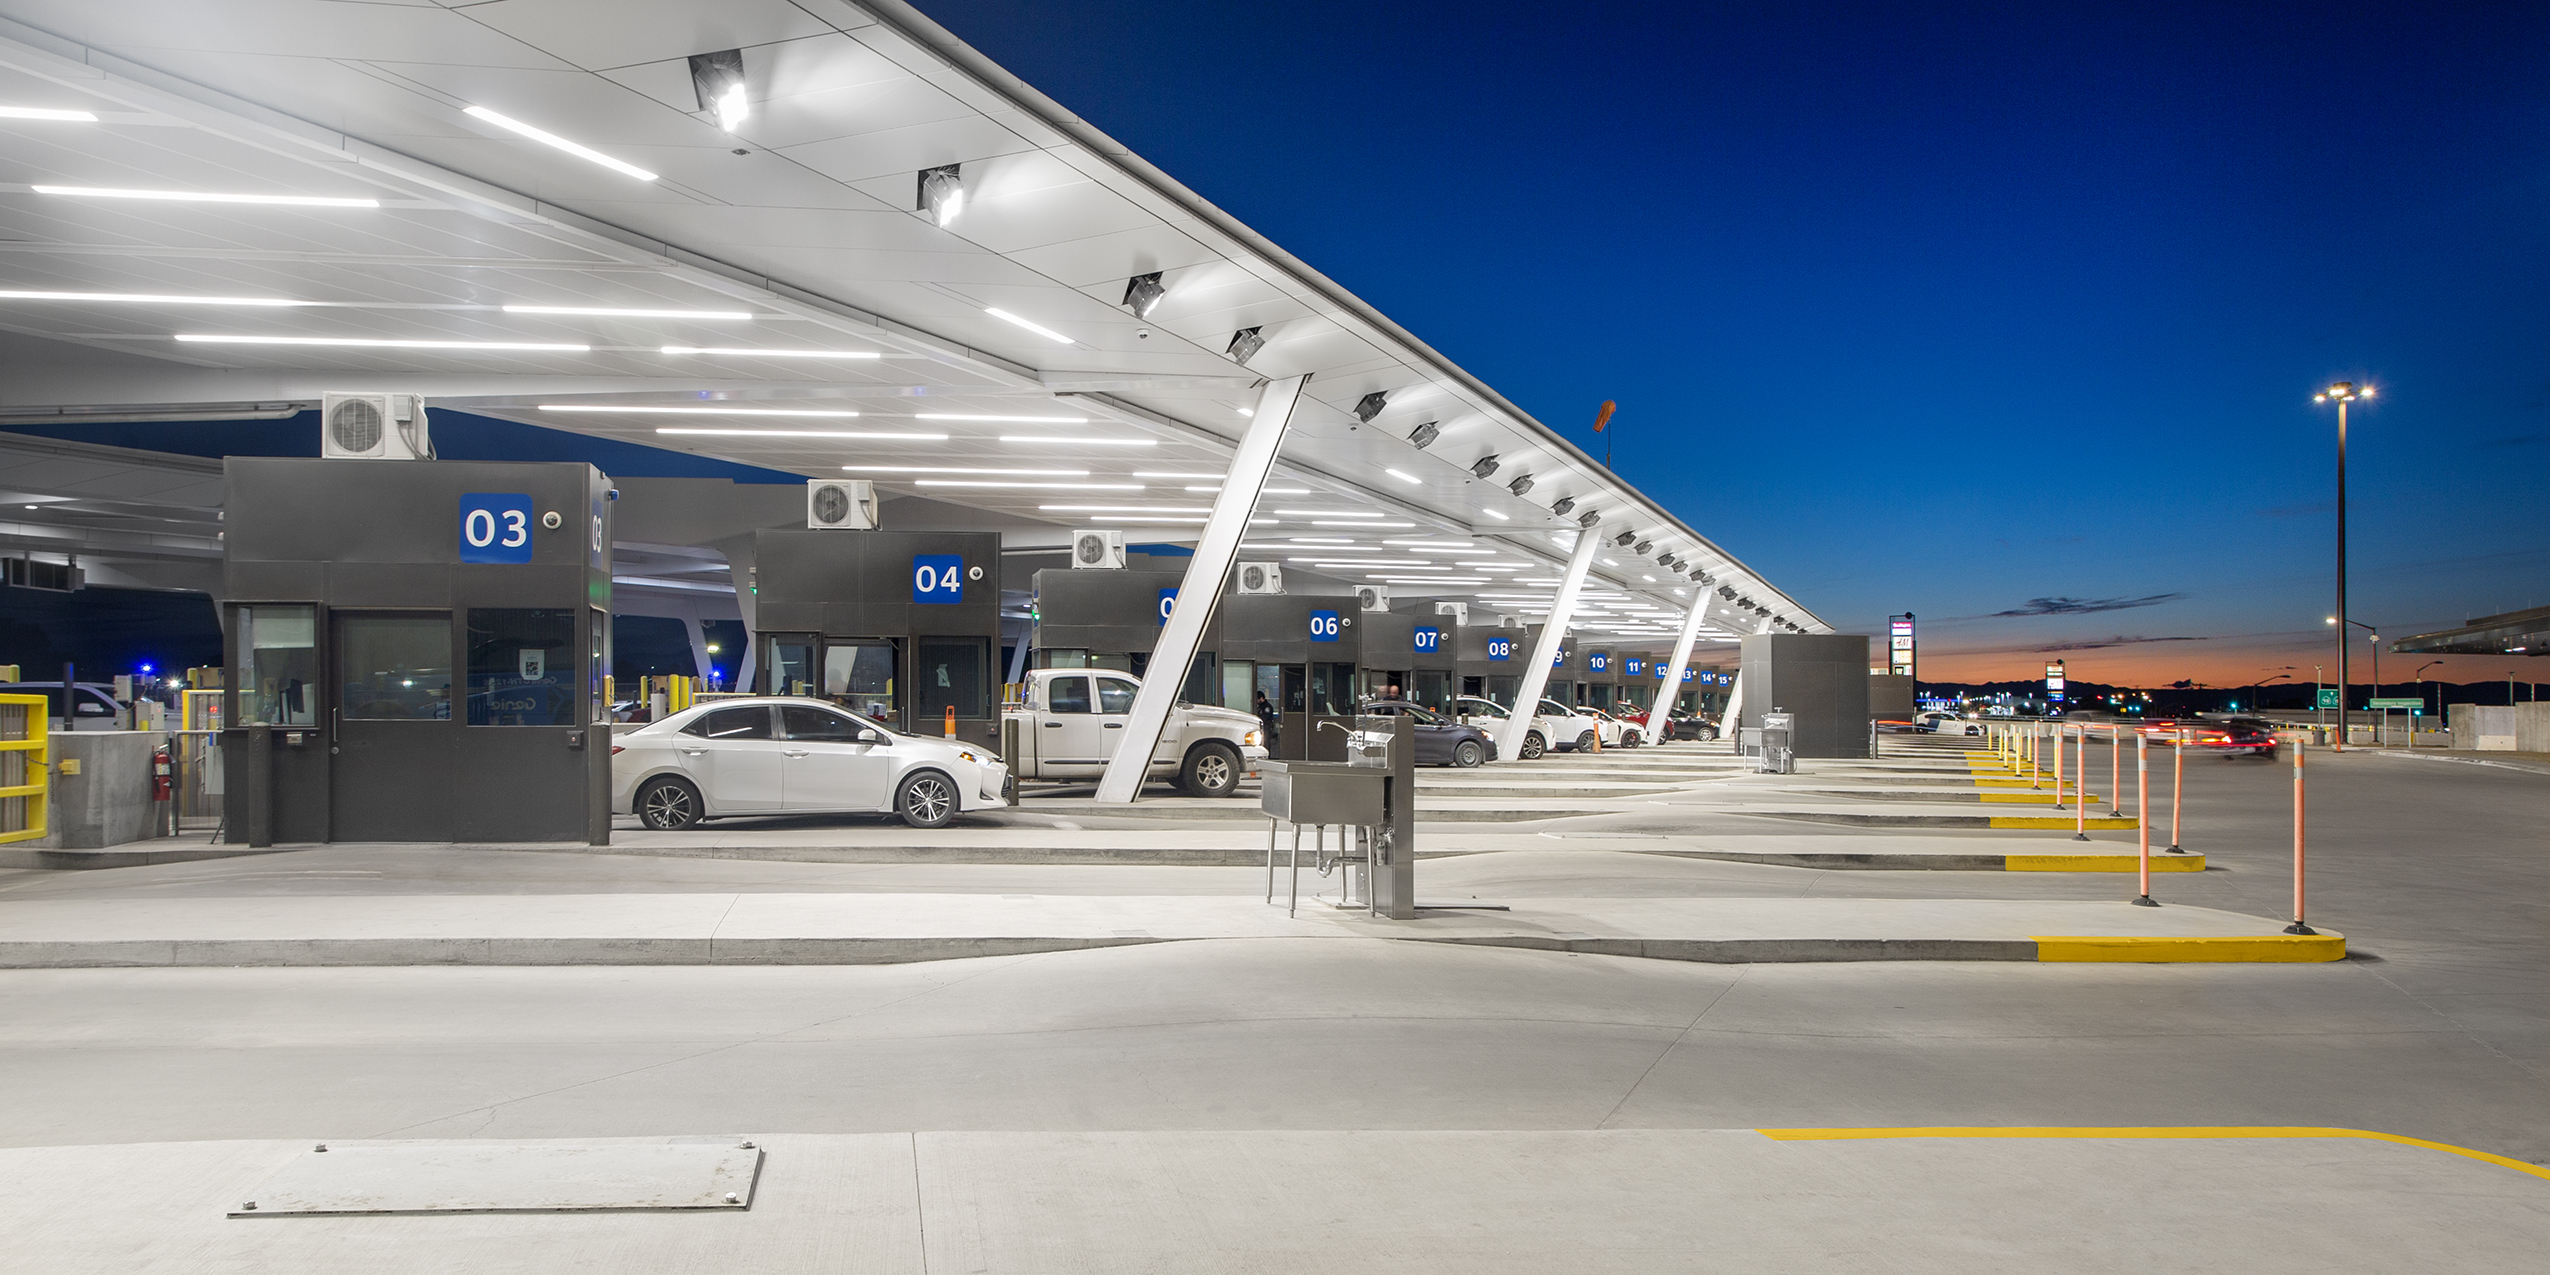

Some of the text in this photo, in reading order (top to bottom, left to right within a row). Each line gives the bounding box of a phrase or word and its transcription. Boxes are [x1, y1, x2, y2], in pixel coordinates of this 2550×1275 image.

[465, 509, 527, 548] 03
[592, 515, 602, 553] 03
[915, 565, 960, 593] 04
[1160, 597, 1175, 619] 0
[1310, 617, 1338, 635] 06
[1415, 632, 1437, 647] 07
[1488, 642, 1509, 656] 08
[1555, 651, 1563, 663] 9
[1590, 657, 1605, 668] 10
[1628, 662, 1639, 672] 11
[1656, 666, 1668, 676] 12
[1682, 670, 1692, 679] 13
[1702, 673, 1712, 682] 14
[1719, 676, 1728, 684] 15
